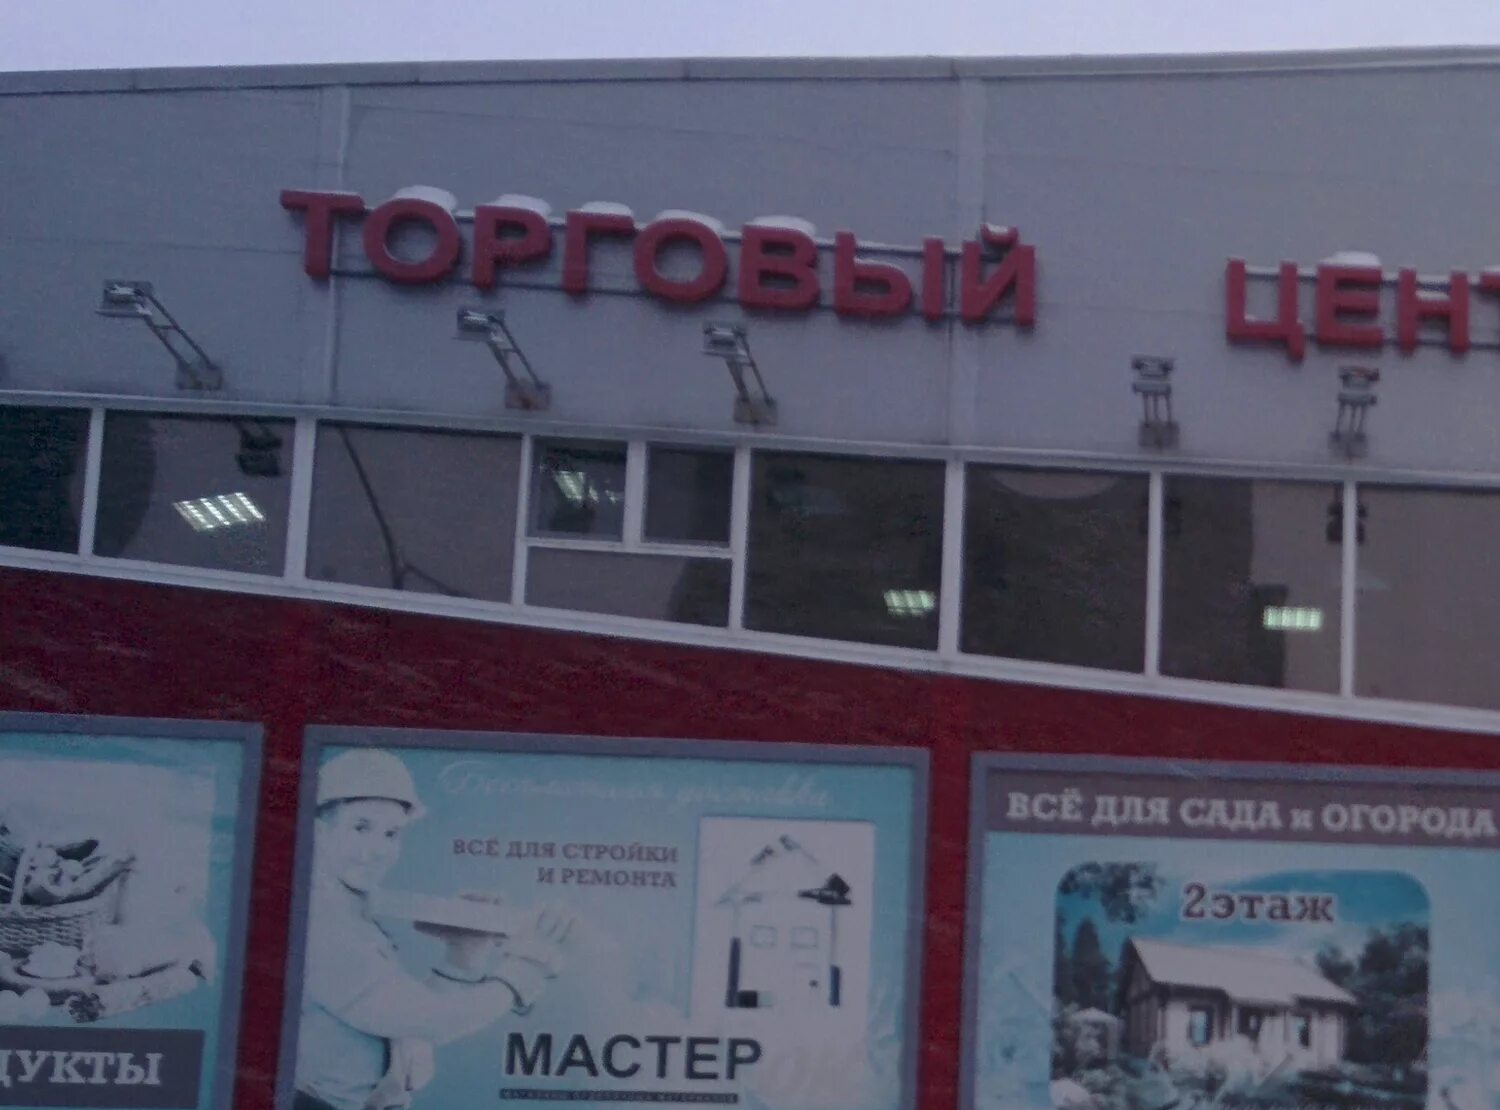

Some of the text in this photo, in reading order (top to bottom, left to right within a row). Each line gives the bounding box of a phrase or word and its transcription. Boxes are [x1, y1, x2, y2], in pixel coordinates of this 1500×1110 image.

[280, 188, 1037, 326] ТОРГОВЫЙ
[1006, 788, 1082, 822] ВСЁ
[1091, 794, 1170, 829] ДЛЯ
[1179, 798, 1282, 831] САДА
[1322, 803, 1498, 838] ОГОРОДА
[506, 840, 556, 861] ДЛЯ
[562, 840, 679, 863] СТРОЙКИ
[536, 868, 678, 889] И РЕМОНТА
[505, 1031, 763, 1081] МАСТЕР
